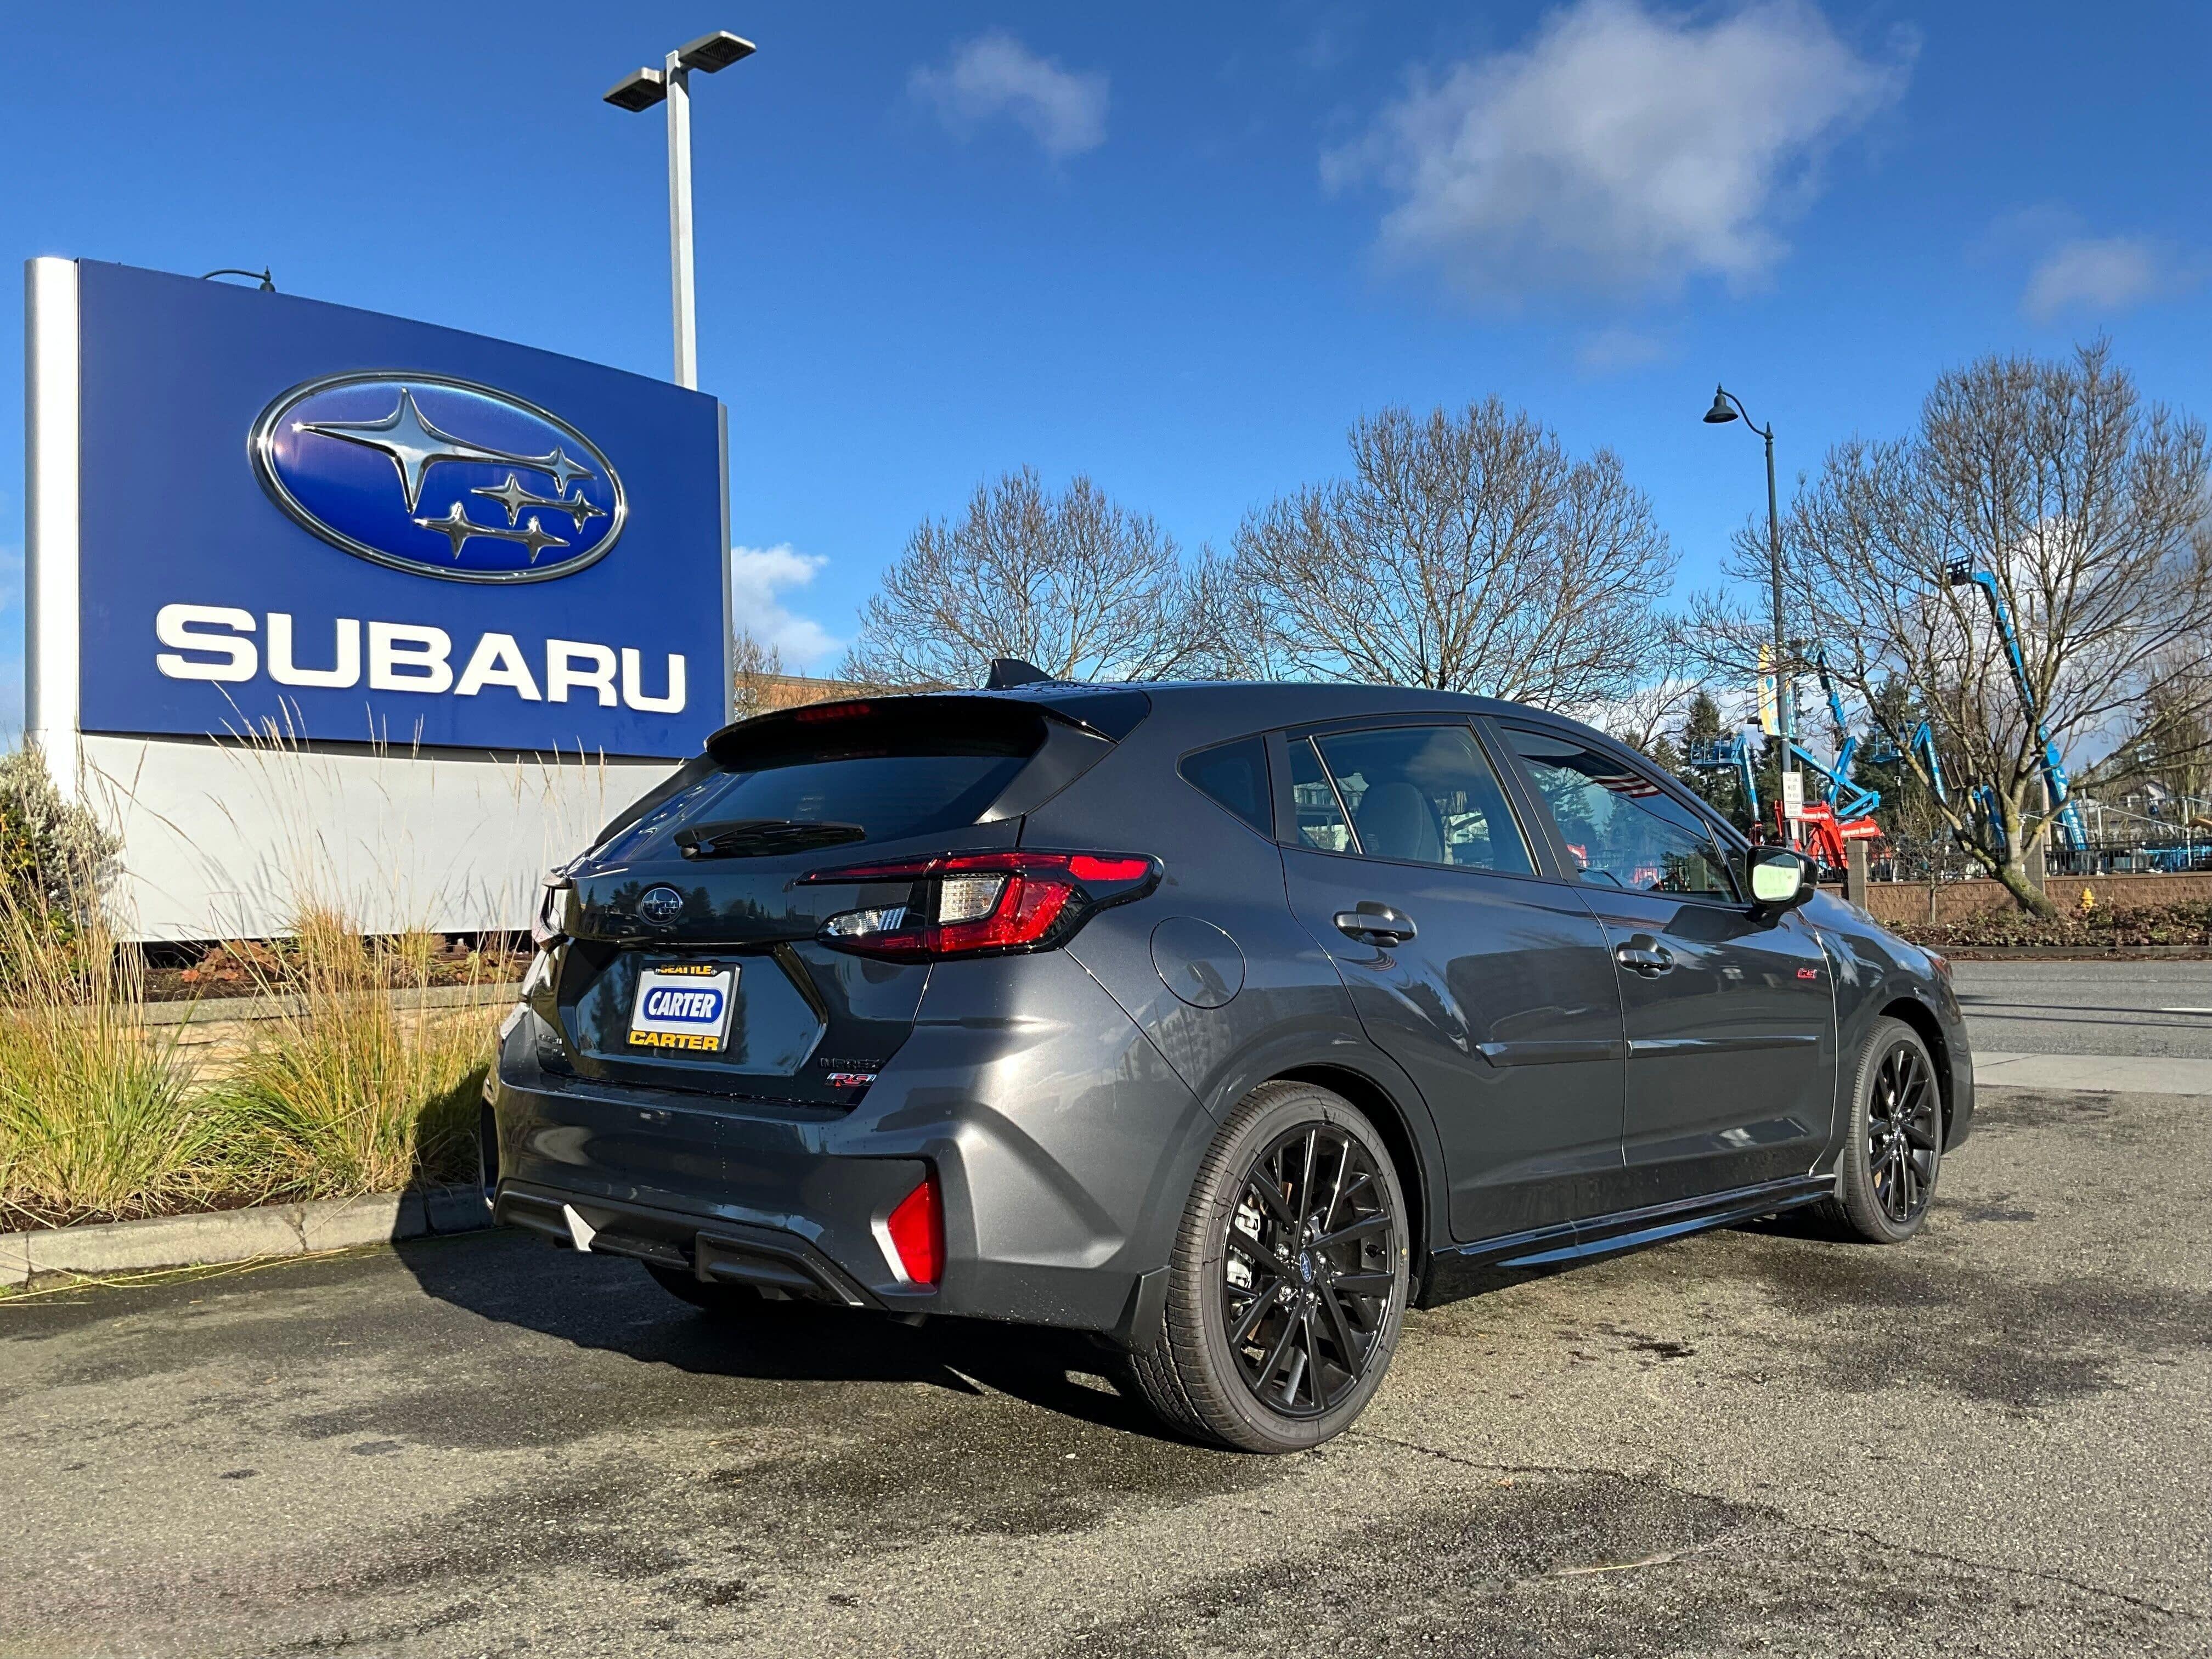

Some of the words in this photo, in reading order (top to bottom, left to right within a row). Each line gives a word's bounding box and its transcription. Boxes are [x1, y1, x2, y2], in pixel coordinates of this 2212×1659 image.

[156, 603, 685, 713] SUBARU
[661, 964, 712, 974] SEATTLE
[648, 991, 716, 1018] CARTER
[629, 1031, 719, 1051] CARTER
[825, 1073, 877, 1087] RS
